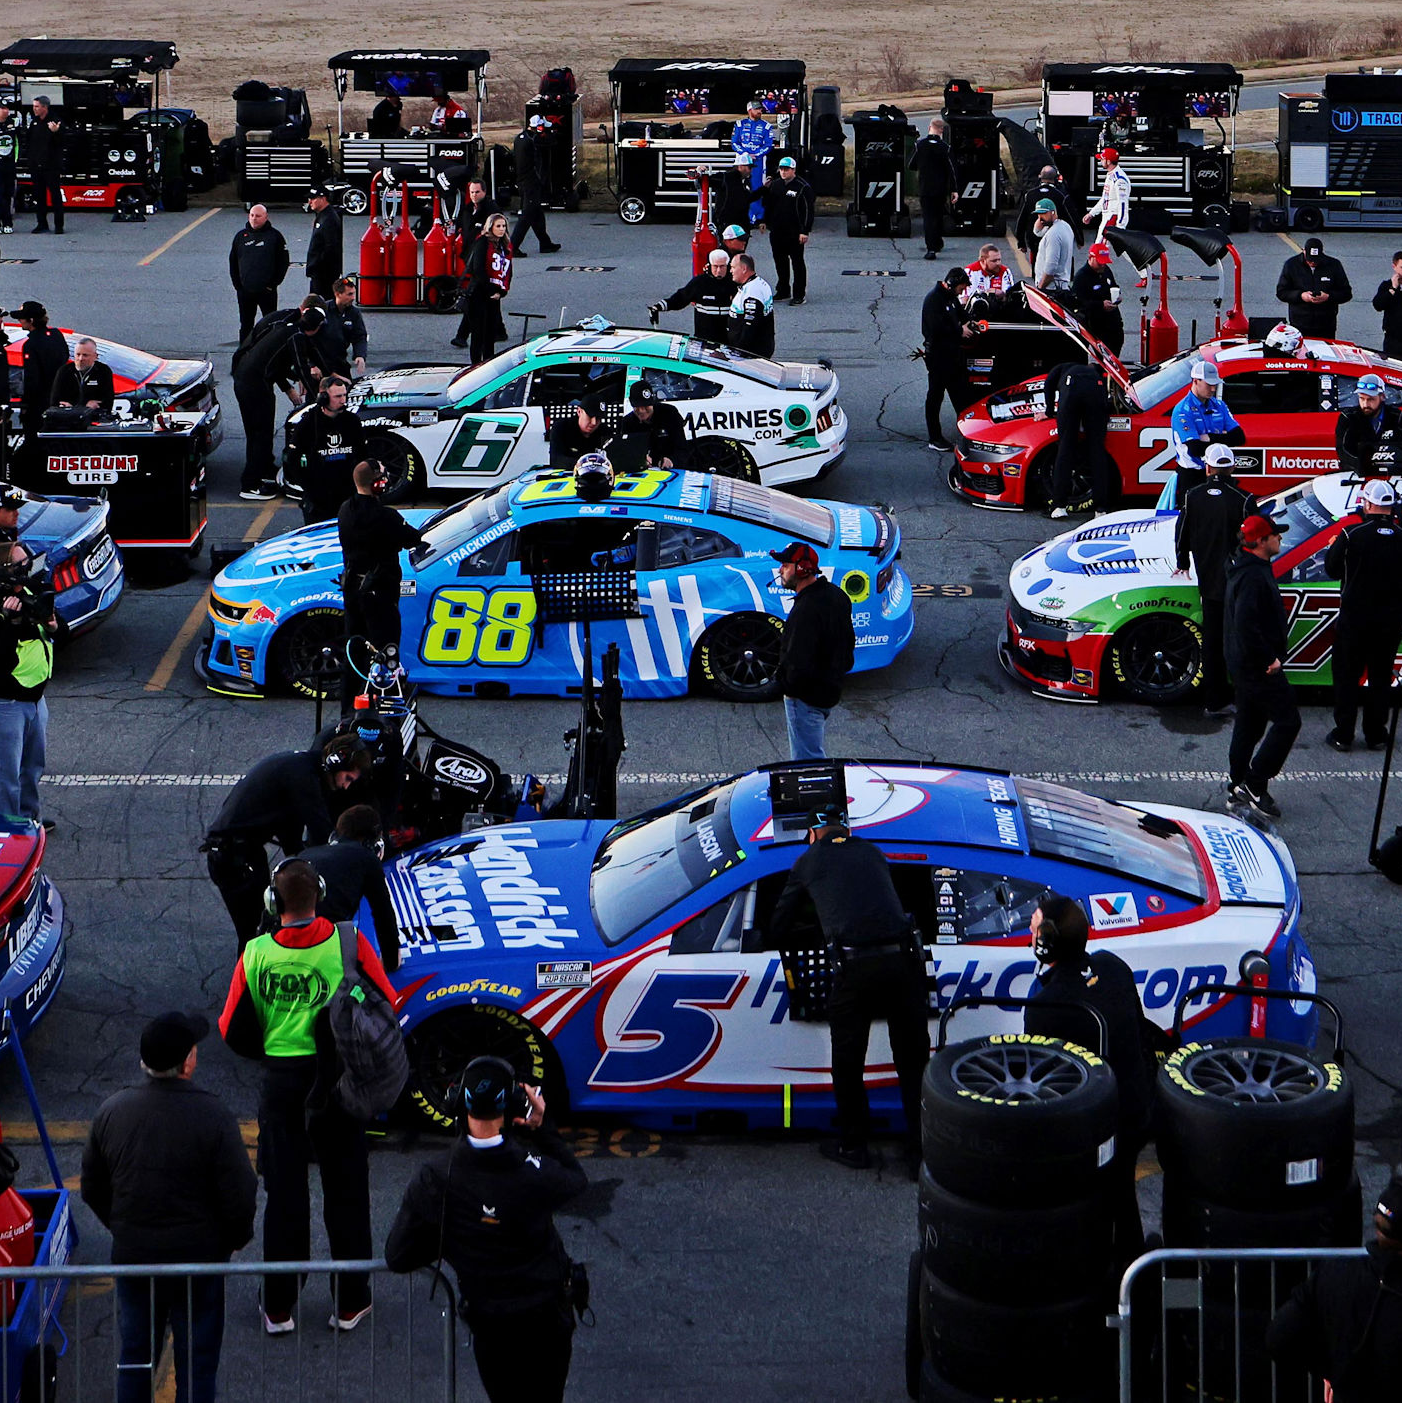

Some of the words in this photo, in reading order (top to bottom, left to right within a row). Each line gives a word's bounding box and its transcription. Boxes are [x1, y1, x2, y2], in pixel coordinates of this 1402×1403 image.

[438, 149, 465, 157] FORD
[864, 141, 893, 152] RFK
[821, 156, 834, 165] 17
[1198, 170, 1219, 179] RFK
[83, 189, 106, 197] RCR
[864, 182, 894, 198] 17
[961, 181, 986, 199] 6
[1264, 362, 1284, 370] Josh
[1284, 362, 1309, 370] Berry
[753, 429, 783, 440] .COM
[448, 414, 524, 474] 6
[47, 455, 139, 473] DISCOUNT
[406, 453, 414, 482] EAGLE
[1271, 455, 1342, 470] Motorcra
[73, 472, 113, 482] TIRE
[663, 513, 693, 525] SIEMENS
[442, 517, 518, 567] TRACKHOUSE
[744, 550, 768, 559] Wendy's
[1129, 598, 1192, 612] GOODYEAR
[422, 585, 539, 667] 88
[1018, 637, 1036, 651] RFK
[703, 645, 715, 681] EAGLE
[1112, 647, 1126, 683] EAGLE
[443, 758, 481, 780] Arai
[995, 804, 1021, 847] HIRING
[696, 822, 724, 864] LARSON
[458, 826, 580, 951] Hendrick
[1098, 915, 1135, 926] Valvoline
[553, 962, 584, 973] NASCAR
[266, 972, 312, 995] FOX
[543, 974, 558, 984] CUP
[559, 973, 585, 984] SERIES
[425, 977, 523, 1002] GOODYEAR
[587, 969, 749, 1087] 5
[472, 1003, 546, 1081] GOODYEAR
[989, 1033, 1104, 1067] GOODYEAR
[1164, 1041, 1206, 1097] GOODYEAR
[1322, 1061, 1344, 1093] EAGLE
[410, 1087, 455, 1129] EAGLE
